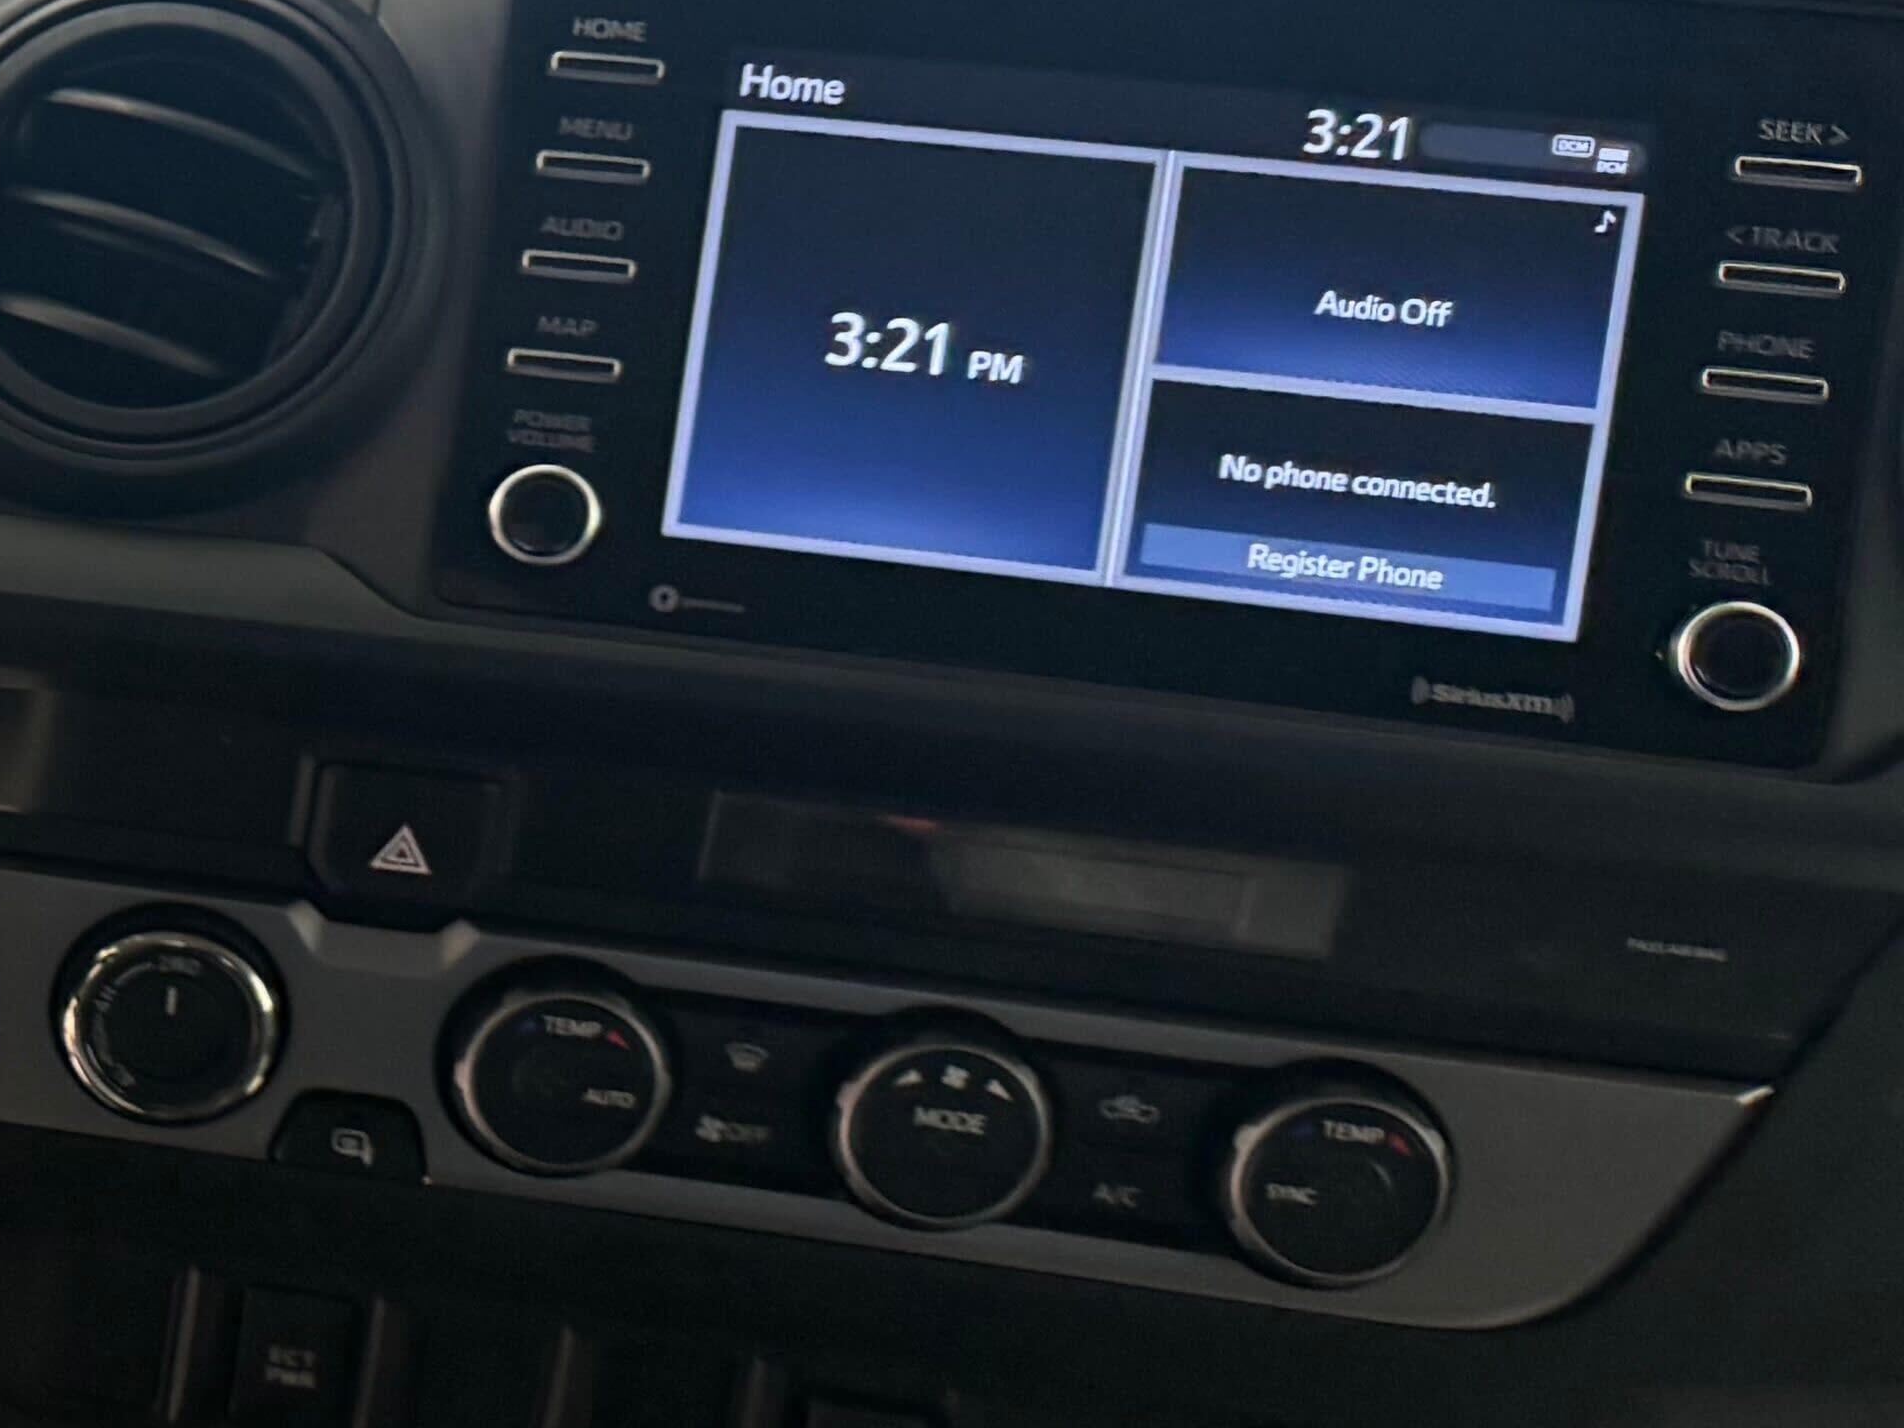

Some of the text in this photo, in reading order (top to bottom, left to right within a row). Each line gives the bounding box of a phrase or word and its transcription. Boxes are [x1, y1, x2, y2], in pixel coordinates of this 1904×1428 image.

[572, 16, 648, 42] HOME
[738, 63, 846, 106] Home
[1303, 108, 1412, 162] 3:21
[558, 116, 634, 141] MENU
[1758, 117, 1824, 145] SEEK
[540, 216, 624, 241] AUDIO
[1751, 225, 1840, 254] TRACK
[1316, 290, 1452, 328] Audio Off
[536, 315, 597, 337] MAP
[824, 311, 1025, 385] 3:21 PM
[1717, 330, 1815, 360] PHONE
[1713, 437, 1789, 465] APPS
[1220, 454, 1496, 510] No phone connected.
[1248, 543, 1444, 591] Register Phone
[544, 1015, 603, 1038] TEMP
[583, 1088, 636, 1109] AUTO
[912, 1107, 985, 1136] MODE
[1323, 1120, 1385, 1144] TEMP
[1093, 1182, 1139, 1208] A/C
